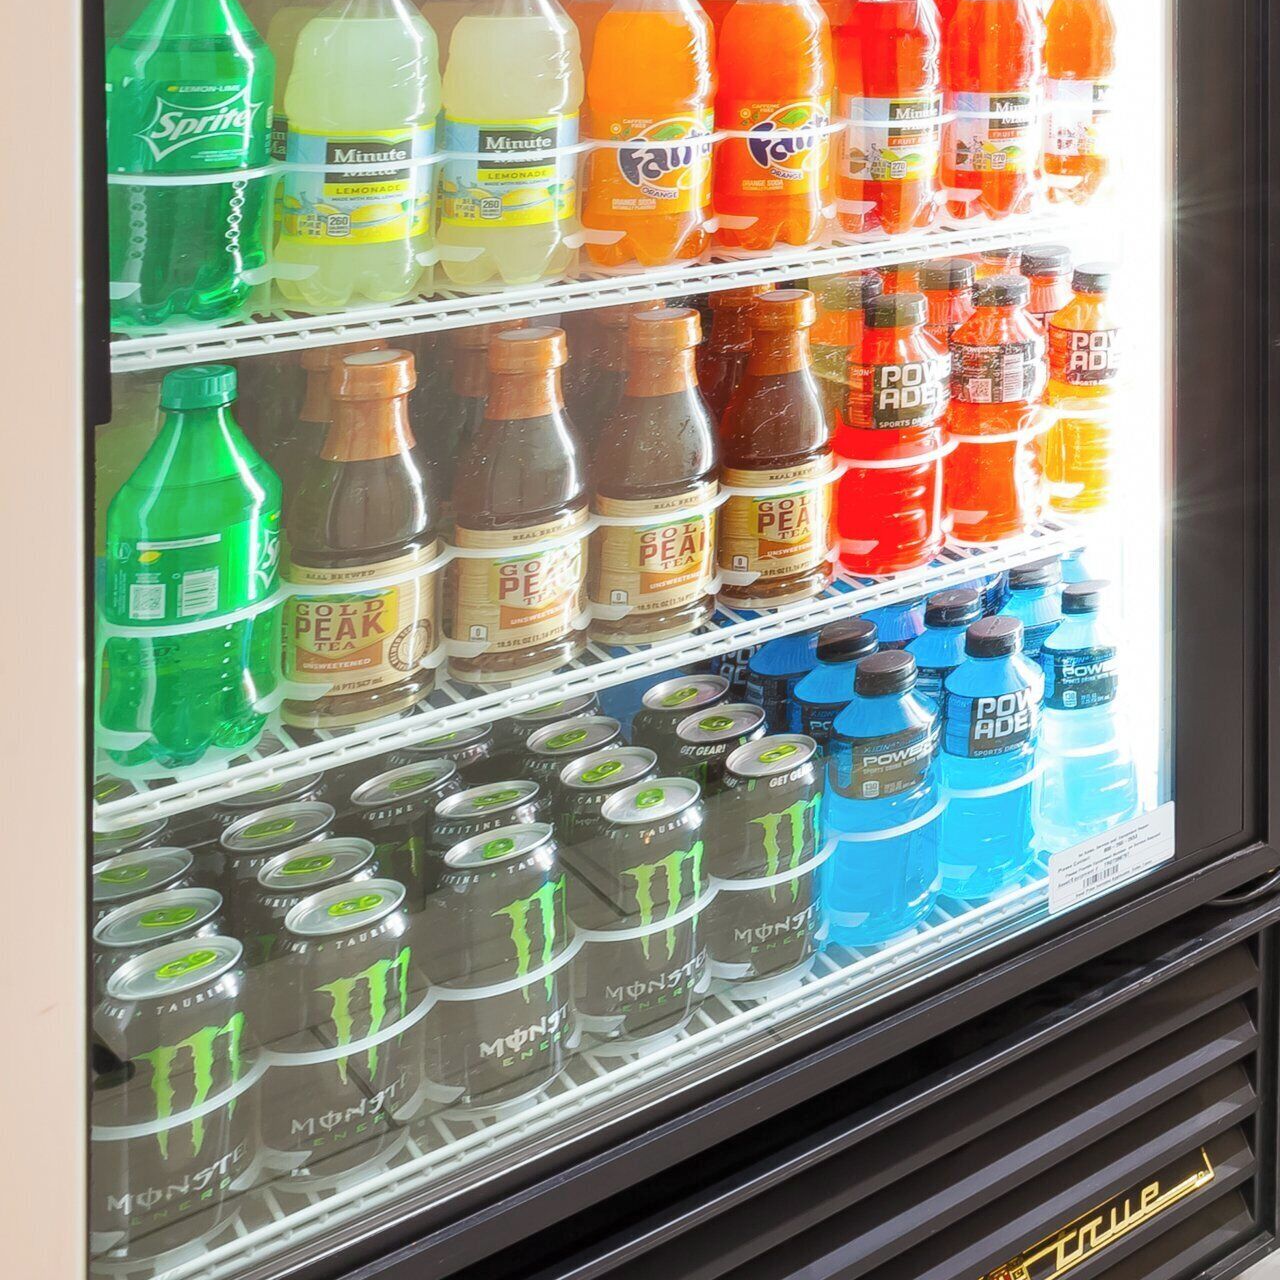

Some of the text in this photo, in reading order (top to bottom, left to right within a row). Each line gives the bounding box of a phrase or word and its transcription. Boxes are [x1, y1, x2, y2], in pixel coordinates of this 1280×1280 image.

[151, 106, 250, 141] Sprite
[485, 136, 551, 151] Minute
[333, 149, 407, 164] Minute
[992, 153, 1006, 161] 270
[892, 162, 905, 170] 270
[488, 170, 547, 180] LEMONADE
[770, 169, 802, 179] ORANGE
[642, 187, 677, 198] ORANGE
[329, 216, 348, 226] 260
[879, 418, 911, 428] SPORTS
[331, 568, 376, 580] BREWED
[295, 599, 386, 618] GOLD
[295, 614, 386, 640] PEAK
[313, 640, 357, 651] TEA
[303, 658, 372, 670] UNSWEETENED
[680, 744, 726, 757] GET GEAR!
[973, 746, 1001, 757] SPORTS
[735, 900, 822, 942] MONSTE
[605, 945, 707, 1002] MONSTE
[107, 1142, 247, 1217] MONSTE
